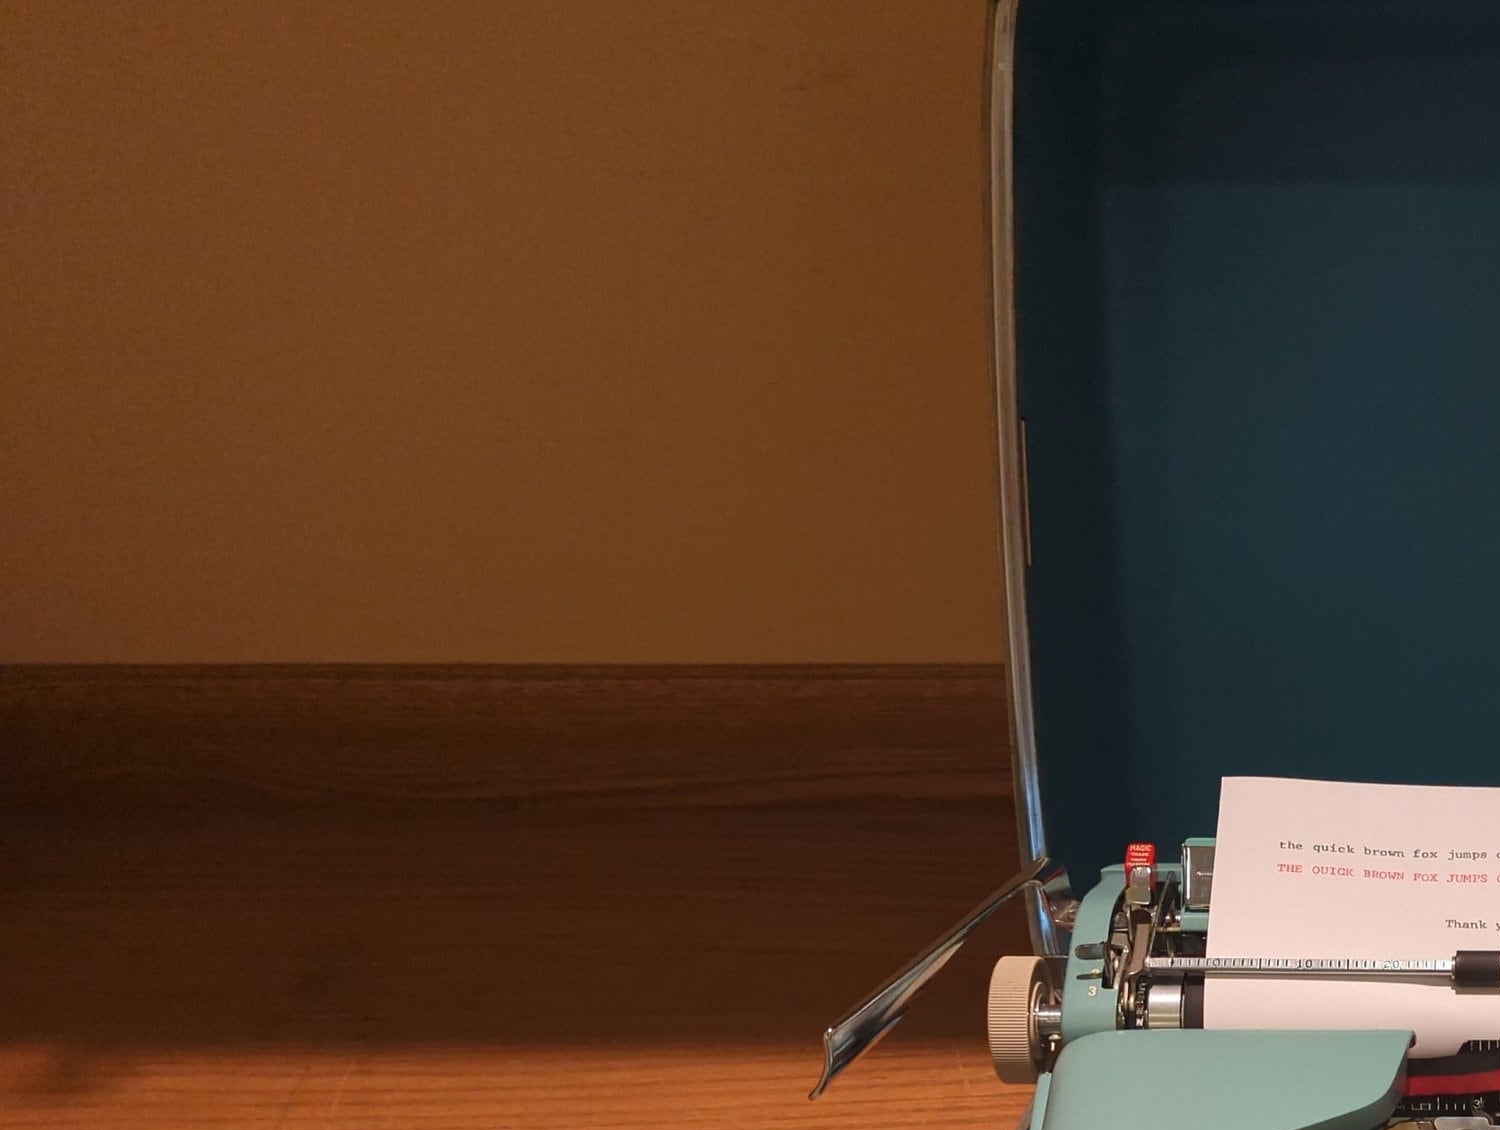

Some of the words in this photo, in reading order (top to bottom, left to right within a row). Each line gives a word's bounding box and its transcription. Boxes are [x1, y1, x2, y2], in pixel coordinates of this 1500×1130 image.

[1280, 840, 1303, 850] the
[1312, 843, 1355, 854] quick
[1364, 847, 1405, 858] brown
[1413, 849, 1438, 859] fox
[1447, 849, 1487, 861] jumps
[1277, 863, 1303, 873] THE
[1363, 869, 1405, 880] BROWN
[1413, 873, 1438, 882] FOX
[1446, 873, 1488, 883] JUMPS
[1445, 919, 1488, 930] Thank
